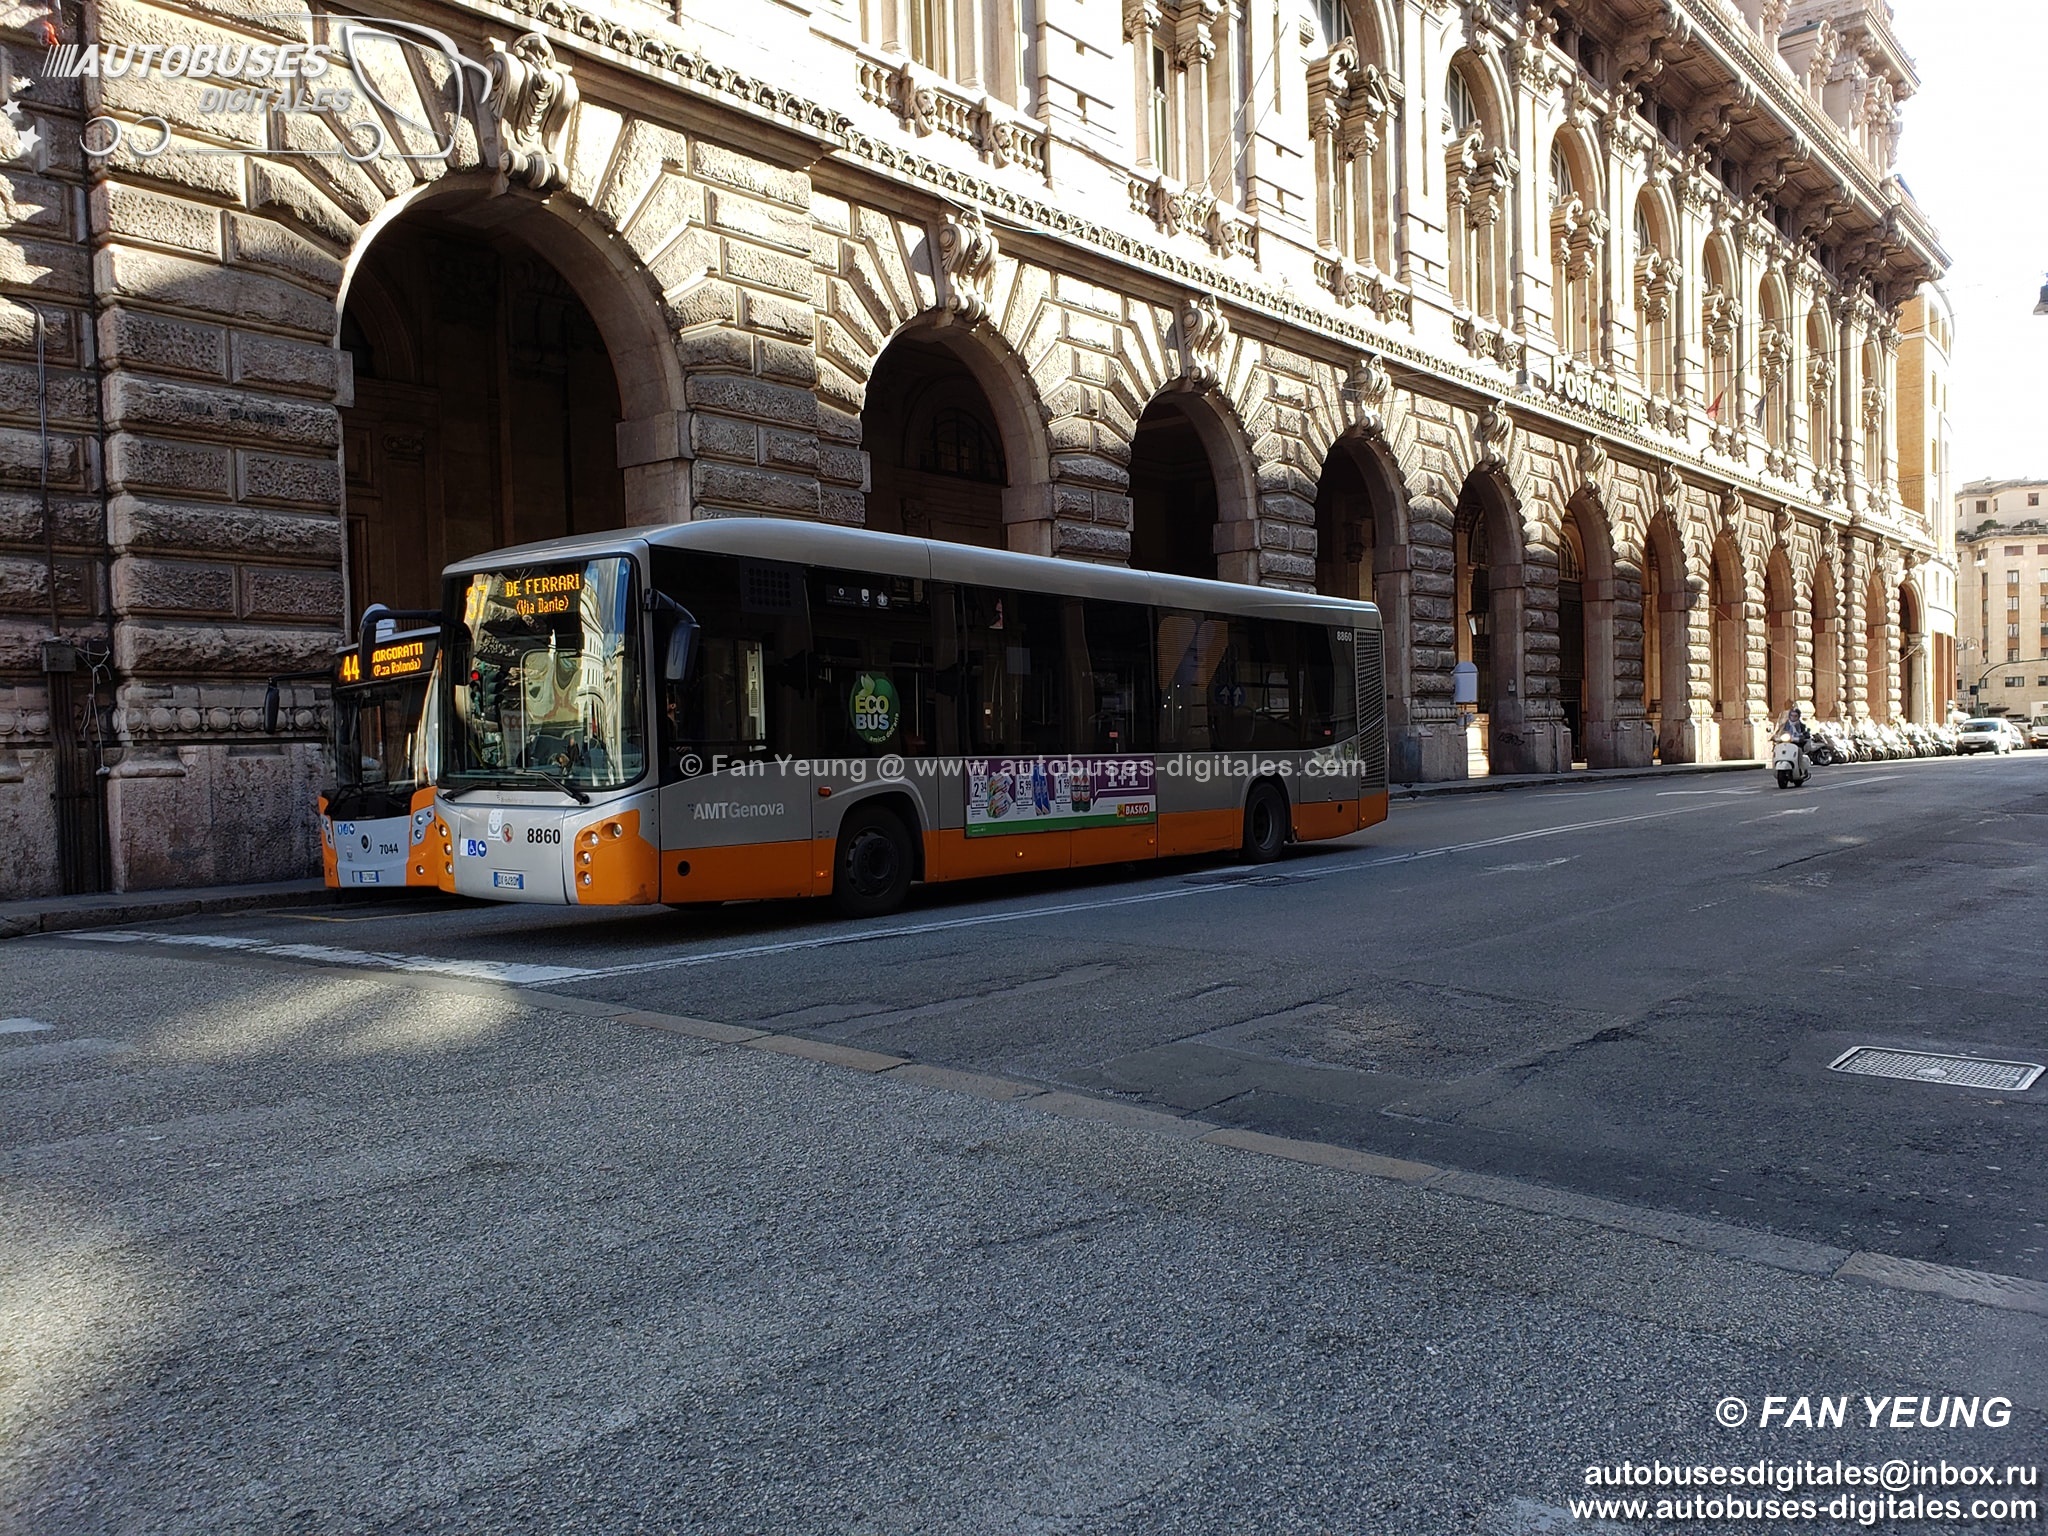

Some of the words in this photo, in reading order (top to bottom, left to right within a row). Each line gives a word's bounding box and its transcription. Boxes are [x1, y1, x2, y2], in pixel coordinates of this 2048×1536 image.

[505, 580, 521, 598] DE
[525, 573, 580, 595] FERRARI
[516, 599, 535, 615] (Via
[538, 595, 569, 613] Dante)
[1336, 631, 1353, 642] 8860
[343, 654, 360, 681] 44
[855, 694, 889, 714] ECO
[855, 713, 890, 731] BUS
[1125, 804, 1149, 816] BASKO
[526, 828, 561, 844] 8860
[379, 843, 399, 855] 7044
